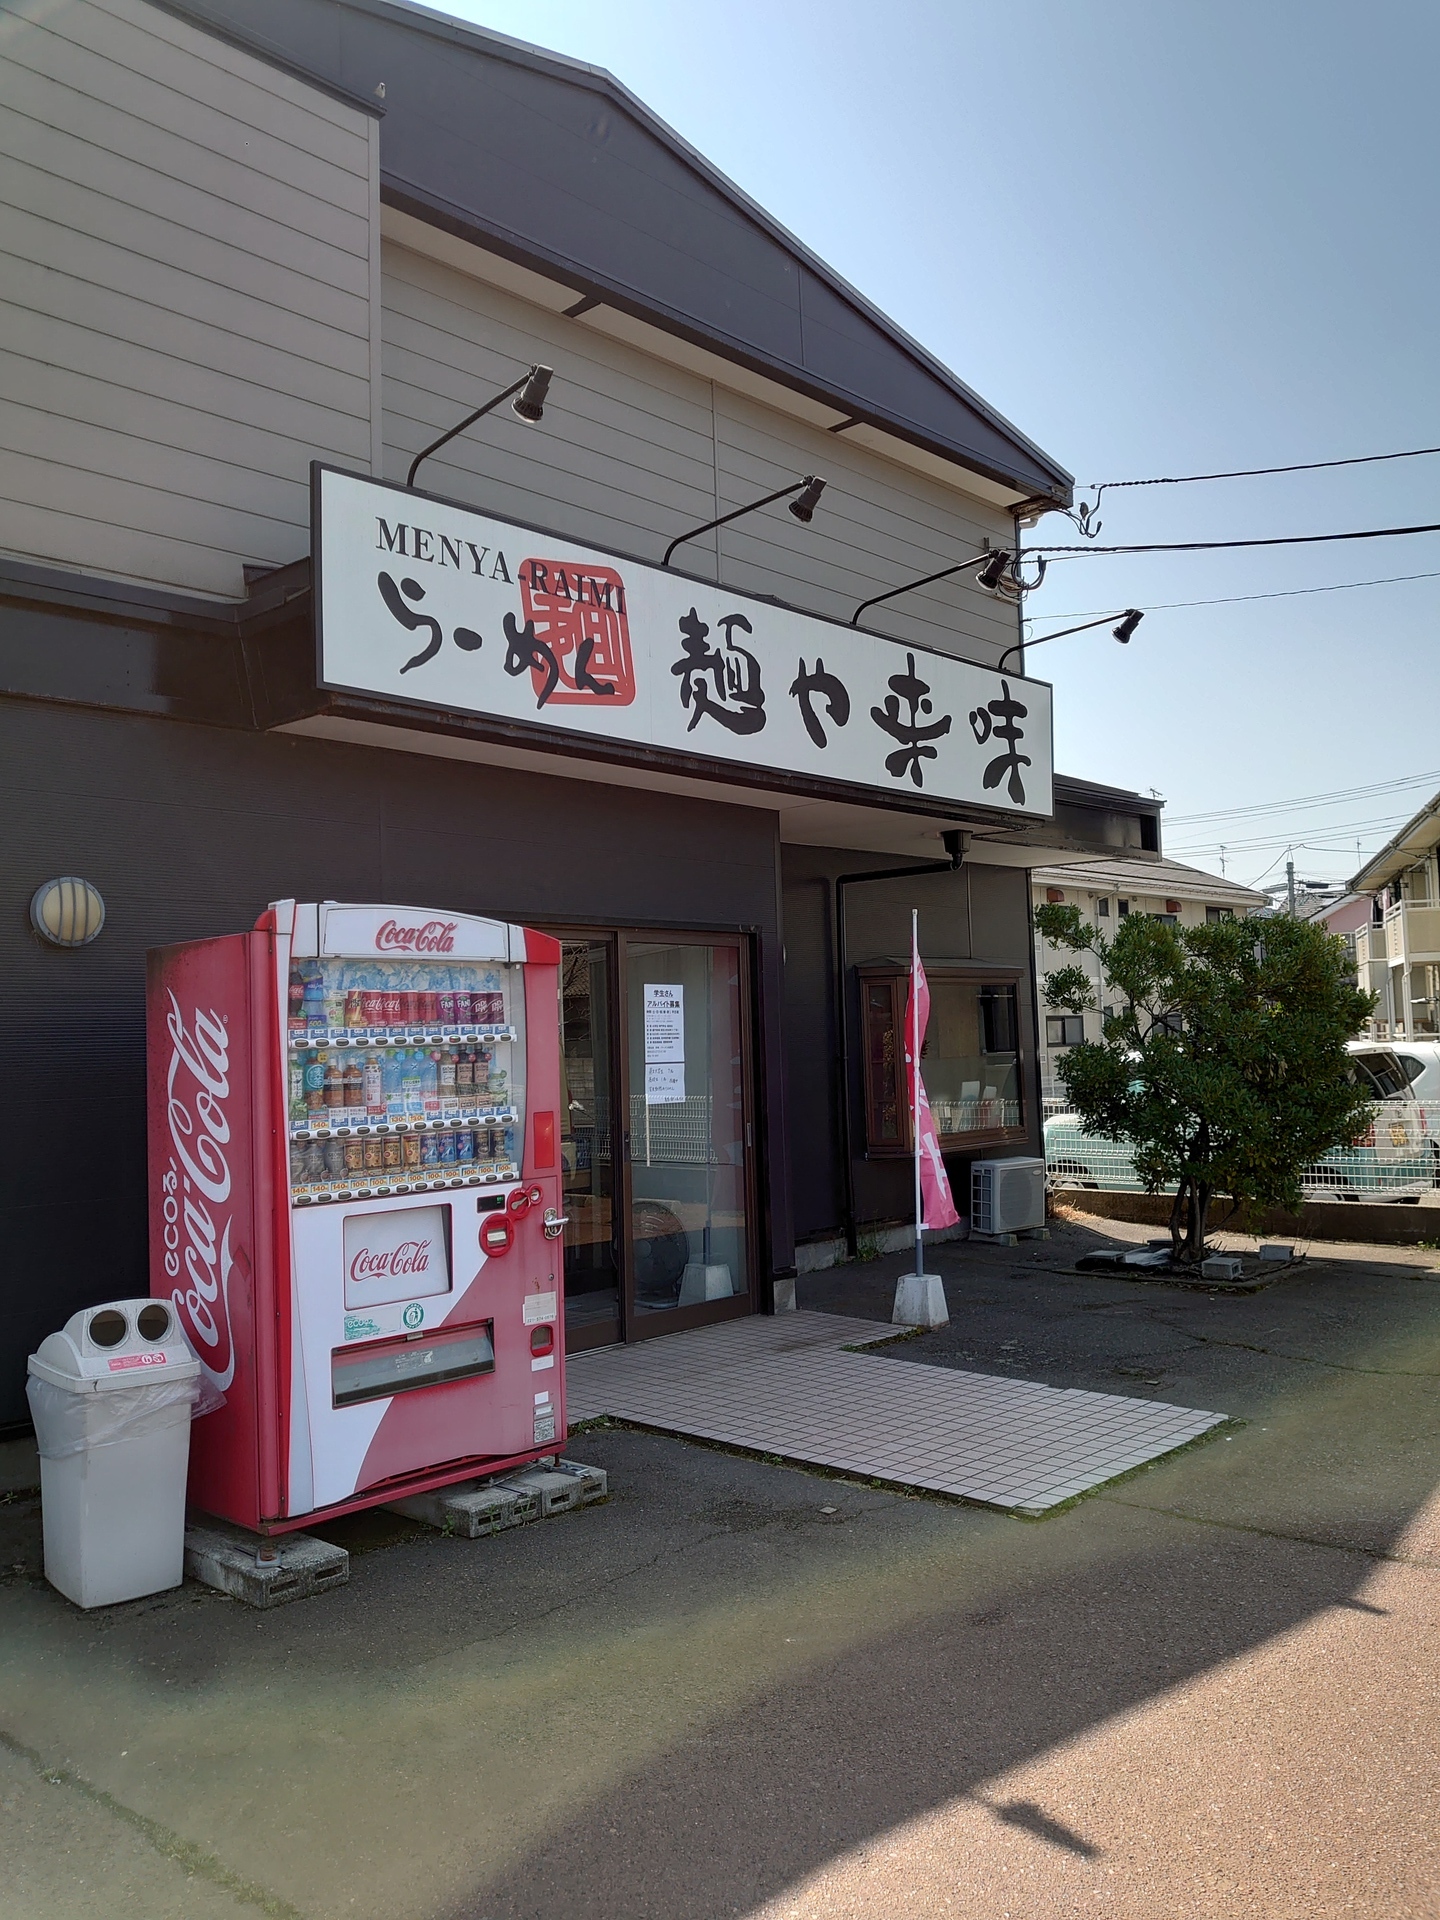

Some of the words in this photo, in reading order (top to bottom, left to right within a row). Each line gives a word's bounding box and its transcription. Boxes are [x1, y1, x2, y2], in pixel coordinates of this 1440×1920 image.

[374, 516, 627, 616] MENYA-RAIMI
[376, 570, 616, 709] らーめん
[374, 918, 459, 953] Coca-Cola
[166, 987, 235, 1392] Coca-Cola
[350, 1239, 432, 1282] Coca-Cola
